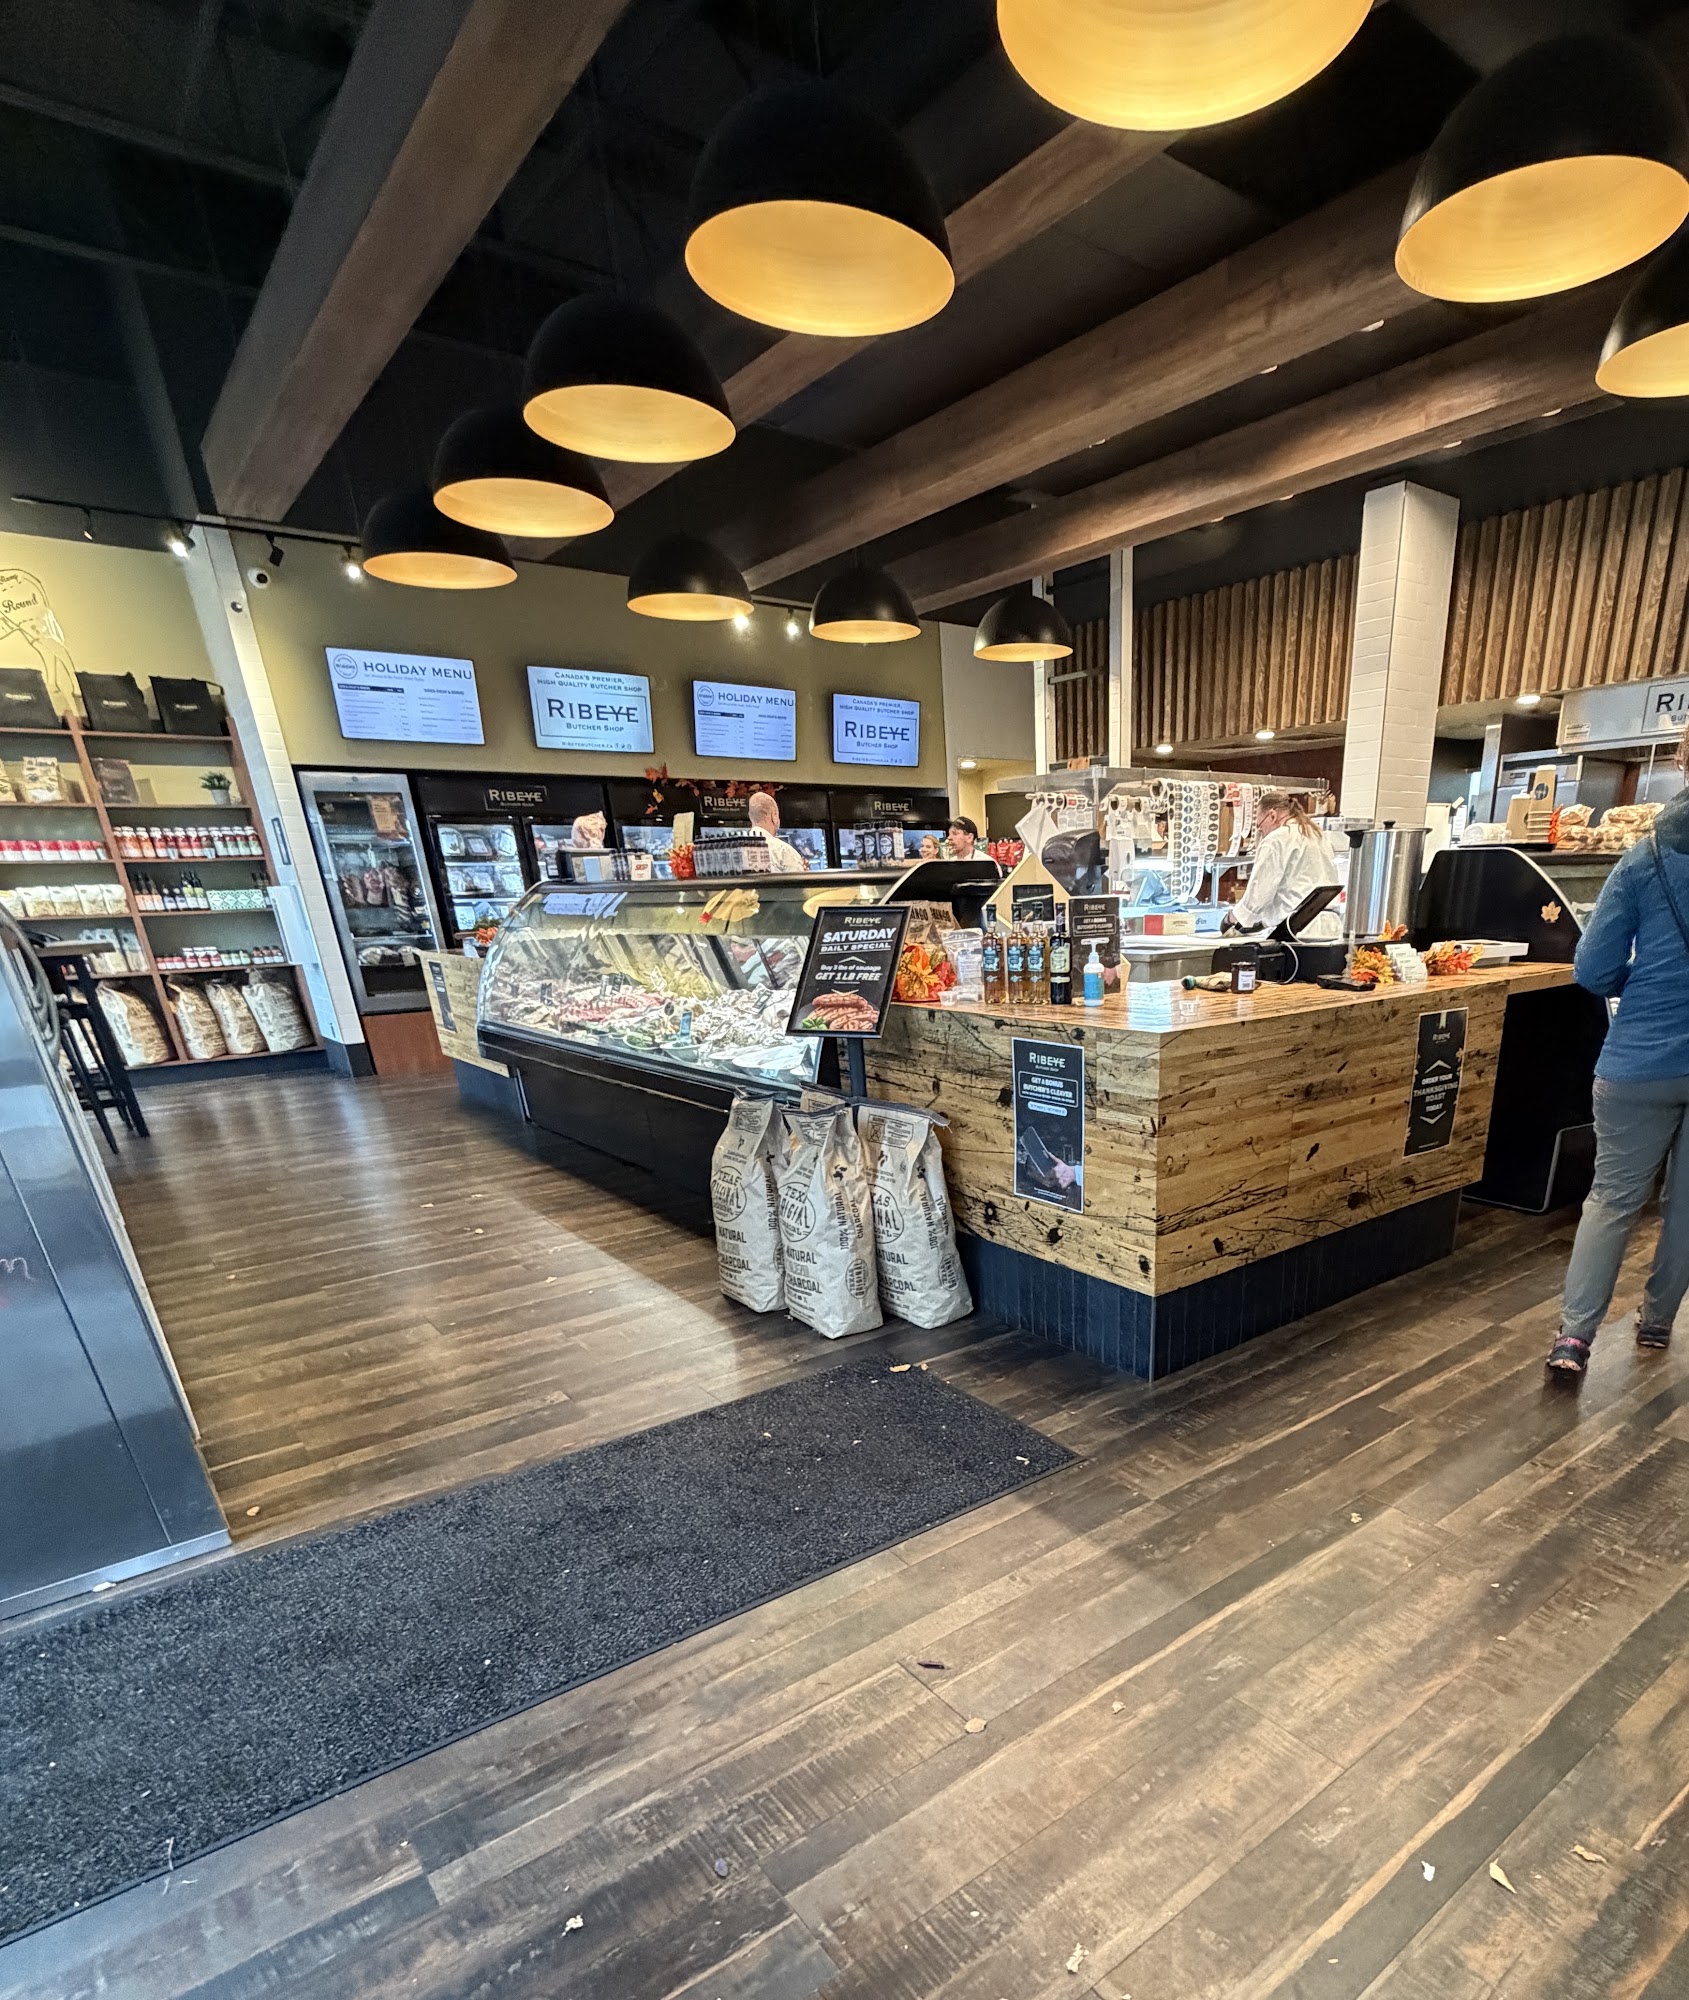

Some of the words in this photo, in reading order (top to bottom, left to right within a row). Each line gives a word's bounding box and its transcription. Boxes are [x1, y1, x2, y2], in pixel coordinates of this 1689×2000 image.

[2, 593, 38, 613] Round
[363, 661, 427, 677] HOLIDAY
[432, 668, 472, 680] MENU
[718, 692, 762, 704] HOLIDAY
[765, 697, 794, 707] MENU
[1656, 693, 1689, 713] RI
[547, 698, 639, 723] RIBEYE
[845, 721, 910, 742] RIBEYE
[489, 789, 543, 802] RIBEYE
[704, 796, 747, 807] RIBEYE
[874, 801, 910, 811] RIBEYE
[844, 916, 882, 924] RIBEYE
[822, 928, 896, 943] SATURDAY
[820, 944, 850, 952] DAILY
[850, 942, 891, 950] SPECIAL
[814, 972, 835, 980] GET
[835, 972, 841, 980] 1
[841, 972, 856, 980] LB
[855, 972, 881, 981] FREE
[1029, 1051, 1066, 1068] RIBEYE
[1050, 1088, 1073, 1098] CLEAVER
[1413, 1081, 1459, 1097] THANKSGIVING
[1425, 1092, 1446, 1103] ROAST
[765, 1174, 776, 1208] NATURAL
[835, 1191, 848, 1227] NATURAL
[849, 1197, 864, 1239] CHARCOAL
[919, 1190, 936, 1228] NATURAL
[767, 1210, 777, 1231] 100%
[840, 1228, 850, 1251] 100%
[928, 1228, 939, 1250] 100%
[853, 1262, 865, 1297] ORIGINAL
